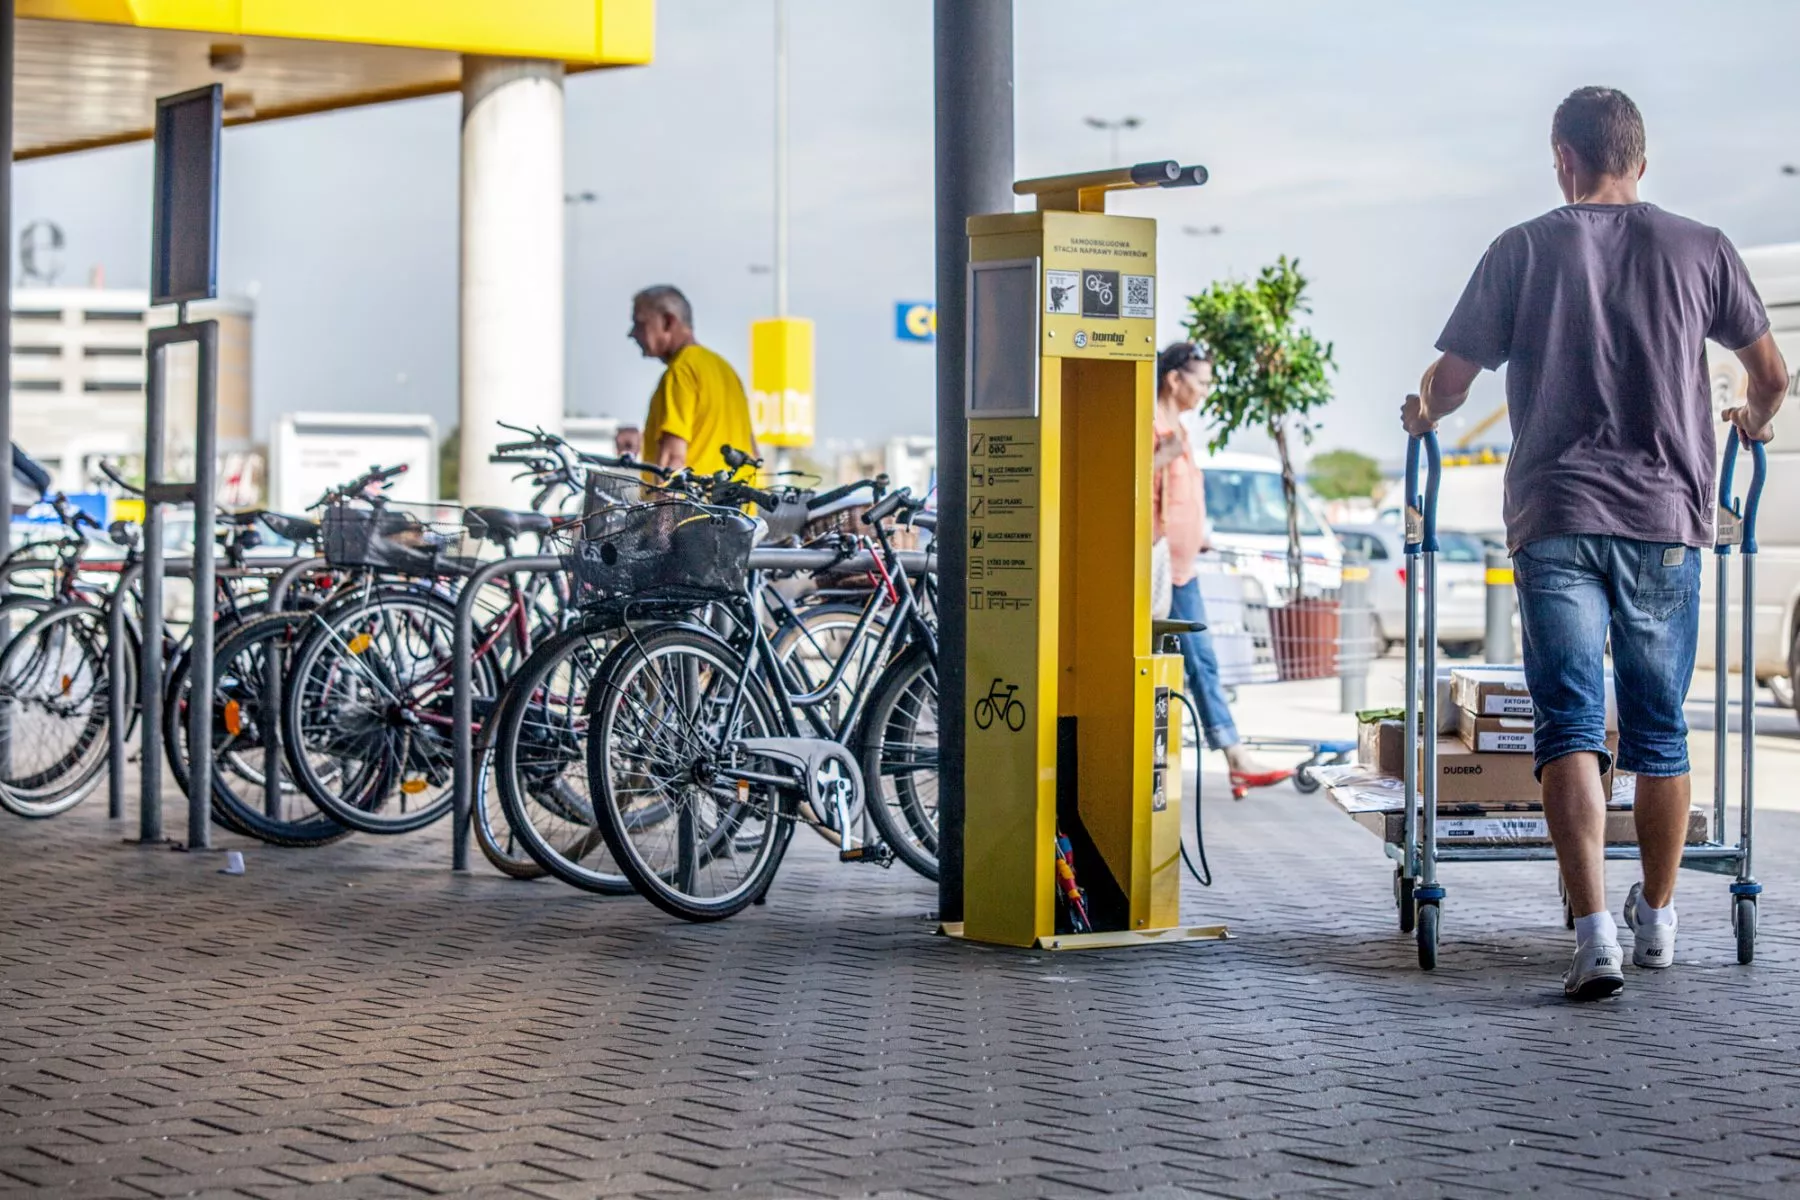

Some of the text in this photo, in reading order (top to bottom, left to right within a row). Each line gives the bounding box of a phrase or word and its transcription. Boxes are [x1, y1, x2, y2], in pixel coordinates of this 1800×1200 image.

[1079, 246, 1112, 256] NAPRAWY
[1645, 948, 1664, 957] NIKE
[1595, 957, 1613, 967] NIKE
